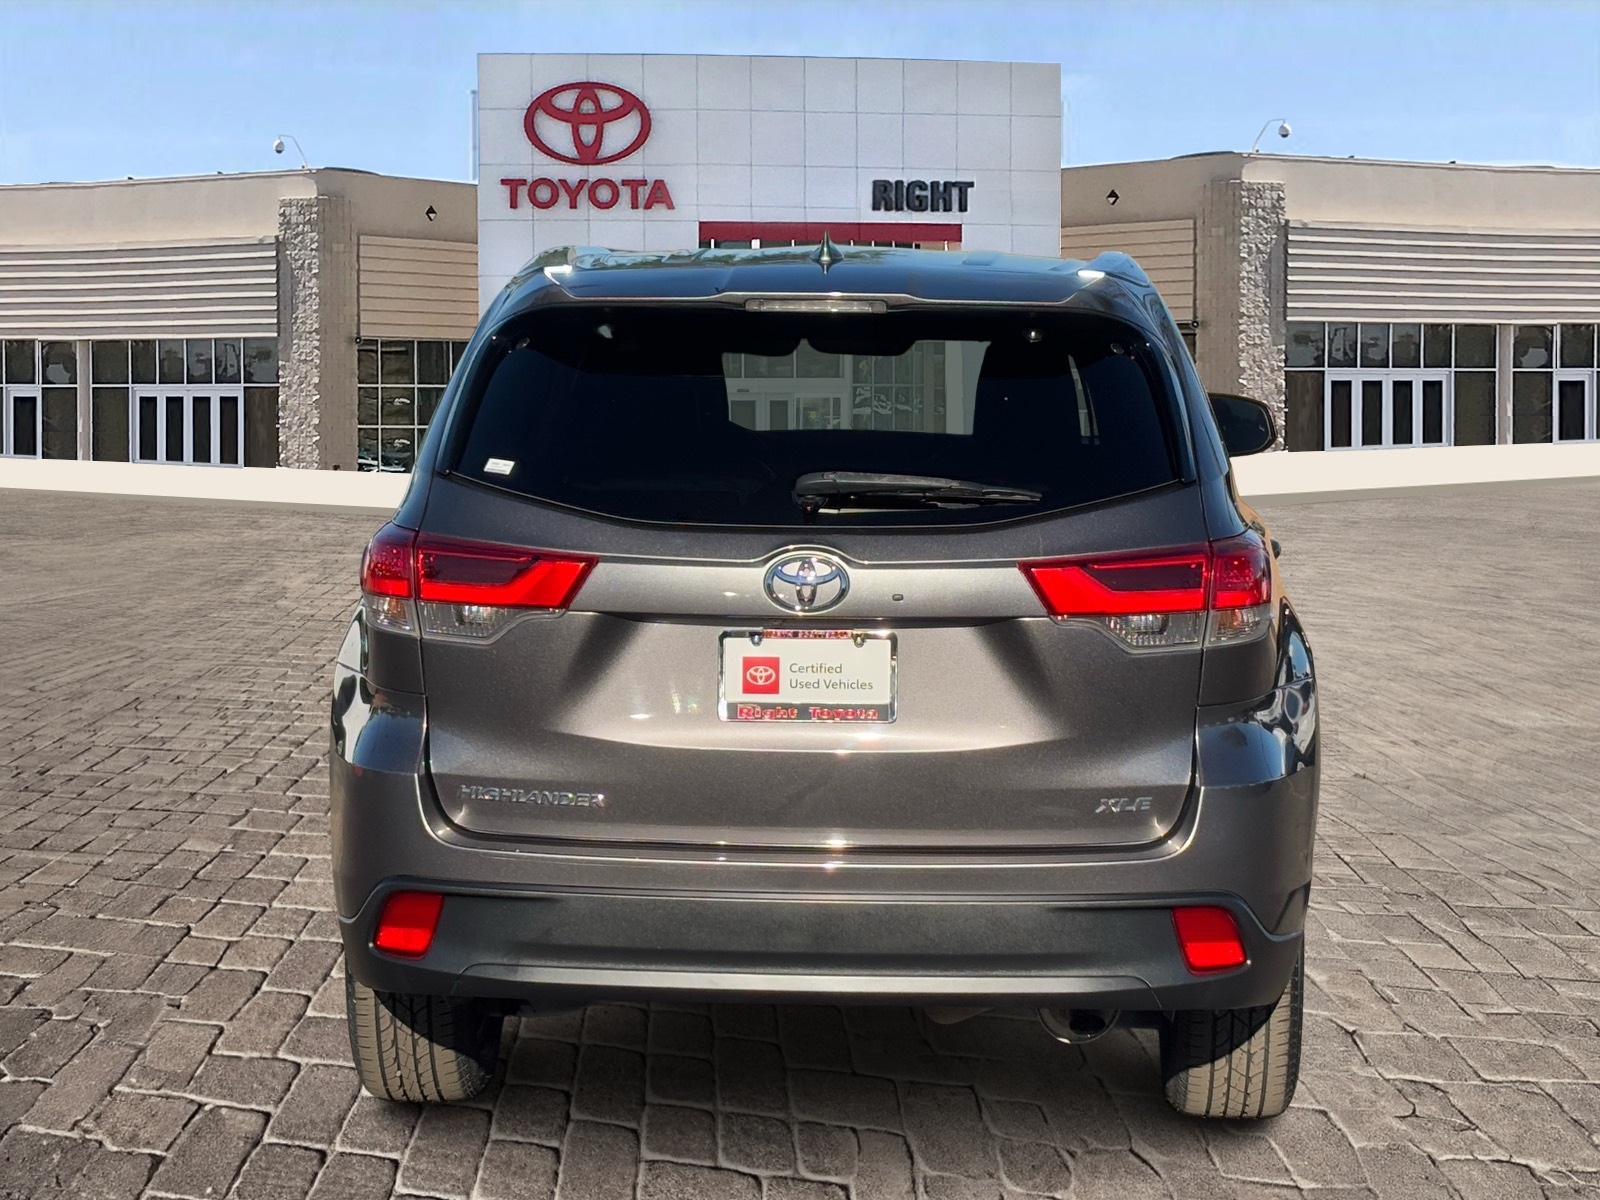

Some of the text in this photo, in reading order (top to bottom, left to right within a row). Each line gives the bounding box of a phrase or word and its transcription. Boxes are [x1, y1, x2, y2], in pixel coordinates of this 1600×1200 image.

[500, 178, 675, 211] TOYOTA
[871, 180, 975, 213] RIGHT
[789, 662, 843, 675] Certified
[789, 678, 874, 691] Used Vehicles
[737, 704, 878, 721] Right Toyota
[459, 784, 606, 808] HIGHLANDER
[1095, 797, 1153, 814] XLE
